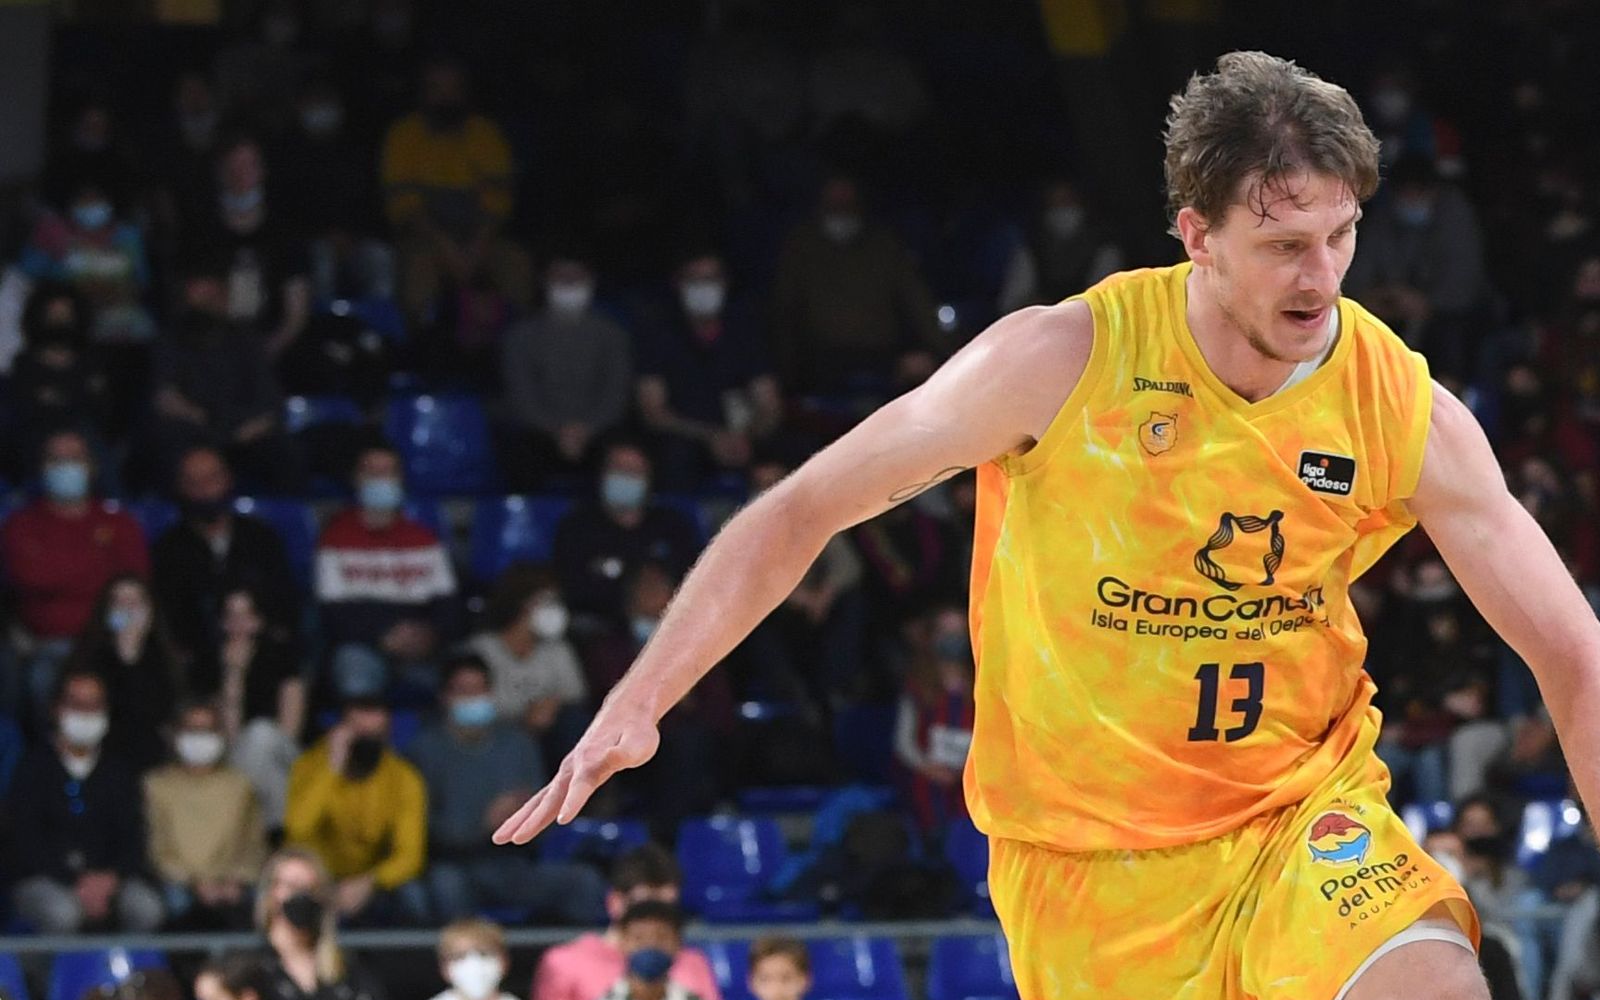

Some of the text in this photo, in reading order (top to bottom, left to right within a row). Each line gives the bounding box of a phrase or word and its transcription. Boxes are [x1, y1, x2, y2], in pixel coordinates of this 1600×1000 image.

[1302, 462, 1326, 477] liga
[1091, 608, 1128, 632] Isla
[1135, 618, 1228, 642] Europea
[1235, 622, 1267, 641] del
[1186, 661, 1265, 743] 13
[1320, 853, 1409, 901] Poema
[1338, 886, 1374, 917] del
